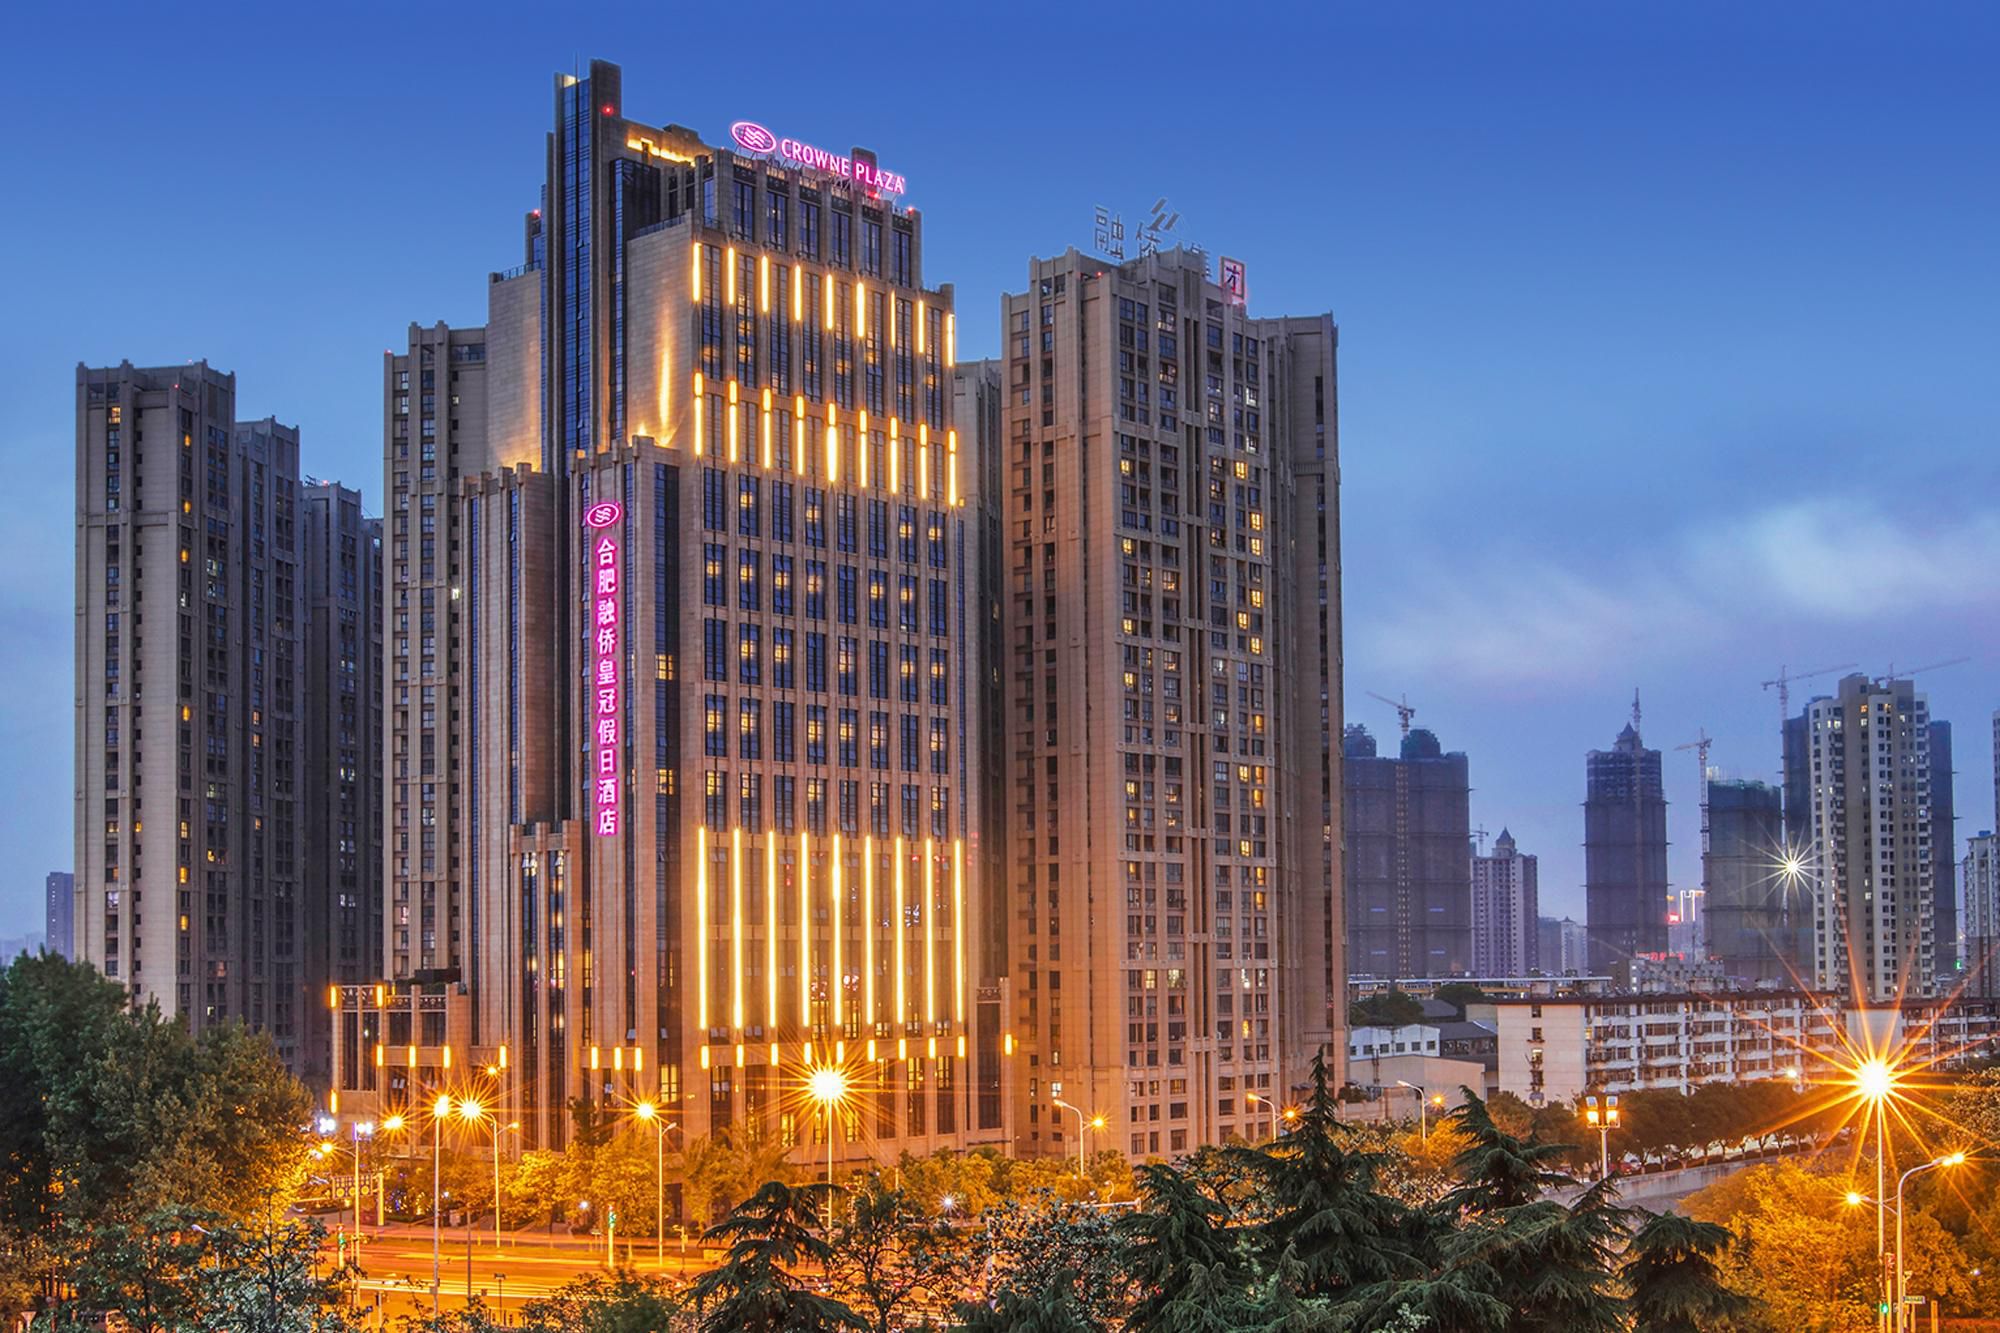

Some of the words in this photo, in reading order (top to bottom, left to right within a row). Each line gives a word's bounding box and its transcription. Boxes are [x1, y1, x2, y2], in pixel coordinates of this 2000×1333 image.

[781, 138, 850, 177] CROWNE
[855, 162, 904, 194] PLAZA
[597, 538, 617, 835] 合肥融侨皇冠假日酒店
